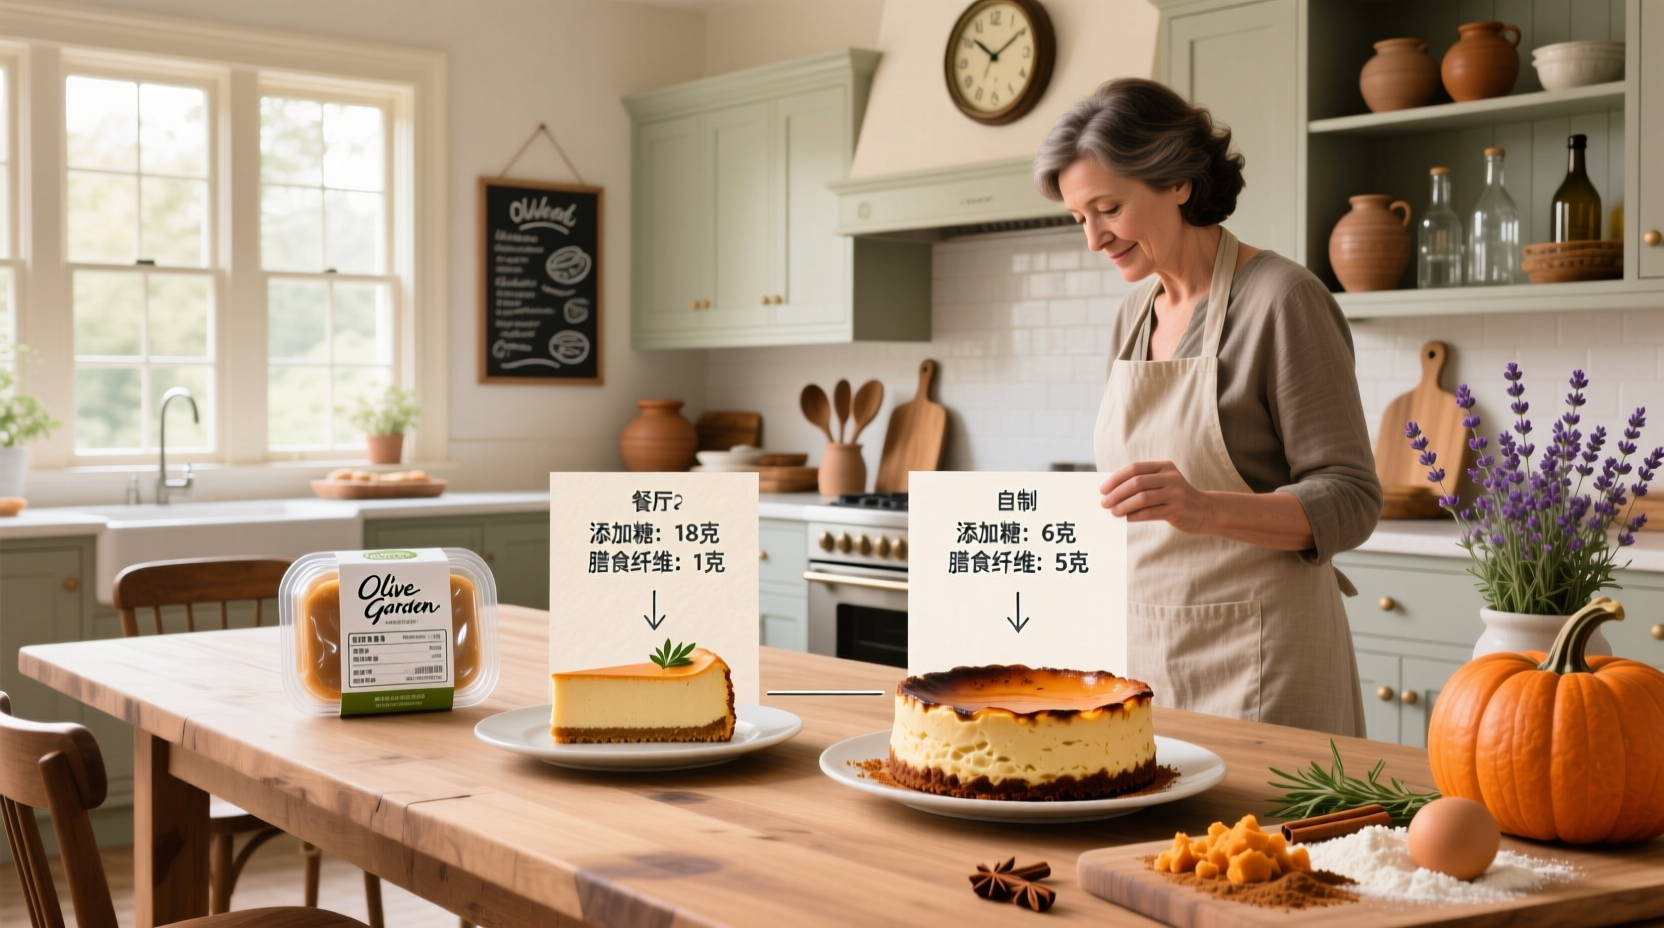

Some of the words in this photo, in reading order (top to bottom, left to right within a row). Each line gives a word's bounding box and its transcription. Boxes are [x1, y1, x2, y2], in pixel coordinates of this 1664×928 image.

[998, 488, 1037, 513] 自制
[358, 573, 421, 600] Olive
[364, 597, 441, 626] Garden
